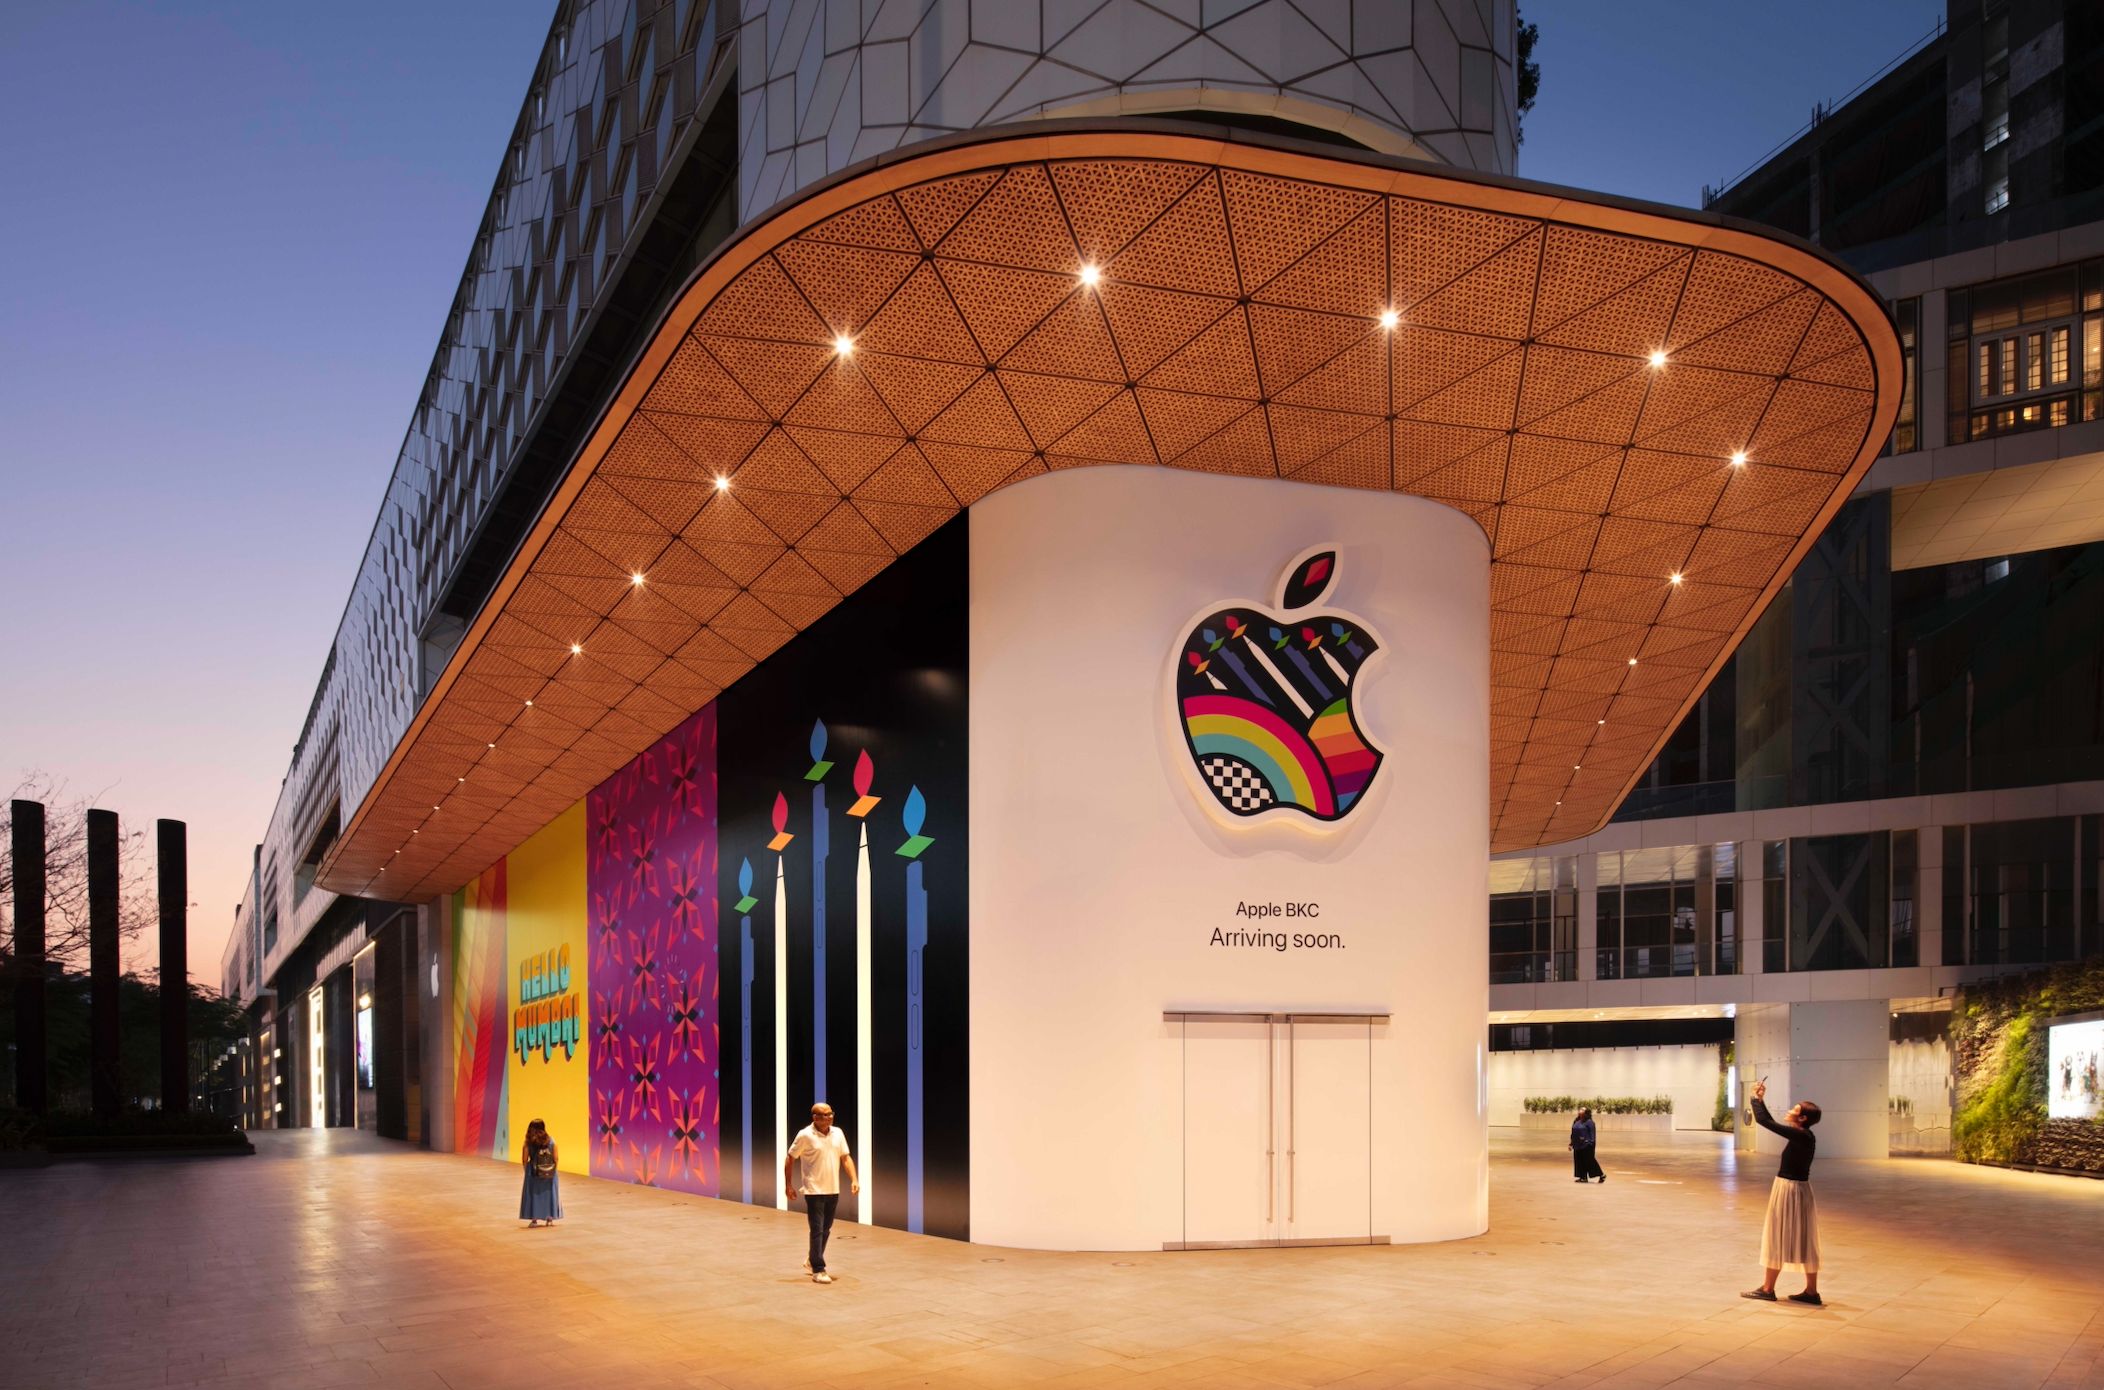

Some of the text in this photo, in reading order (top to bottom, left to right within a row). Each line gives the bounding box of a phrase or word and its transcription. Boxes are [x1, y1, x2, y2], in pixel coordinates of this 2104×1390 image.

[1236, 901, 1319, 919] Apple BKC
[1210, 927, 1345, 951] Arriving soon.
[520, 943, 570, 1004] HELLO
[514, 992, 580, 1066] MUMBAI
